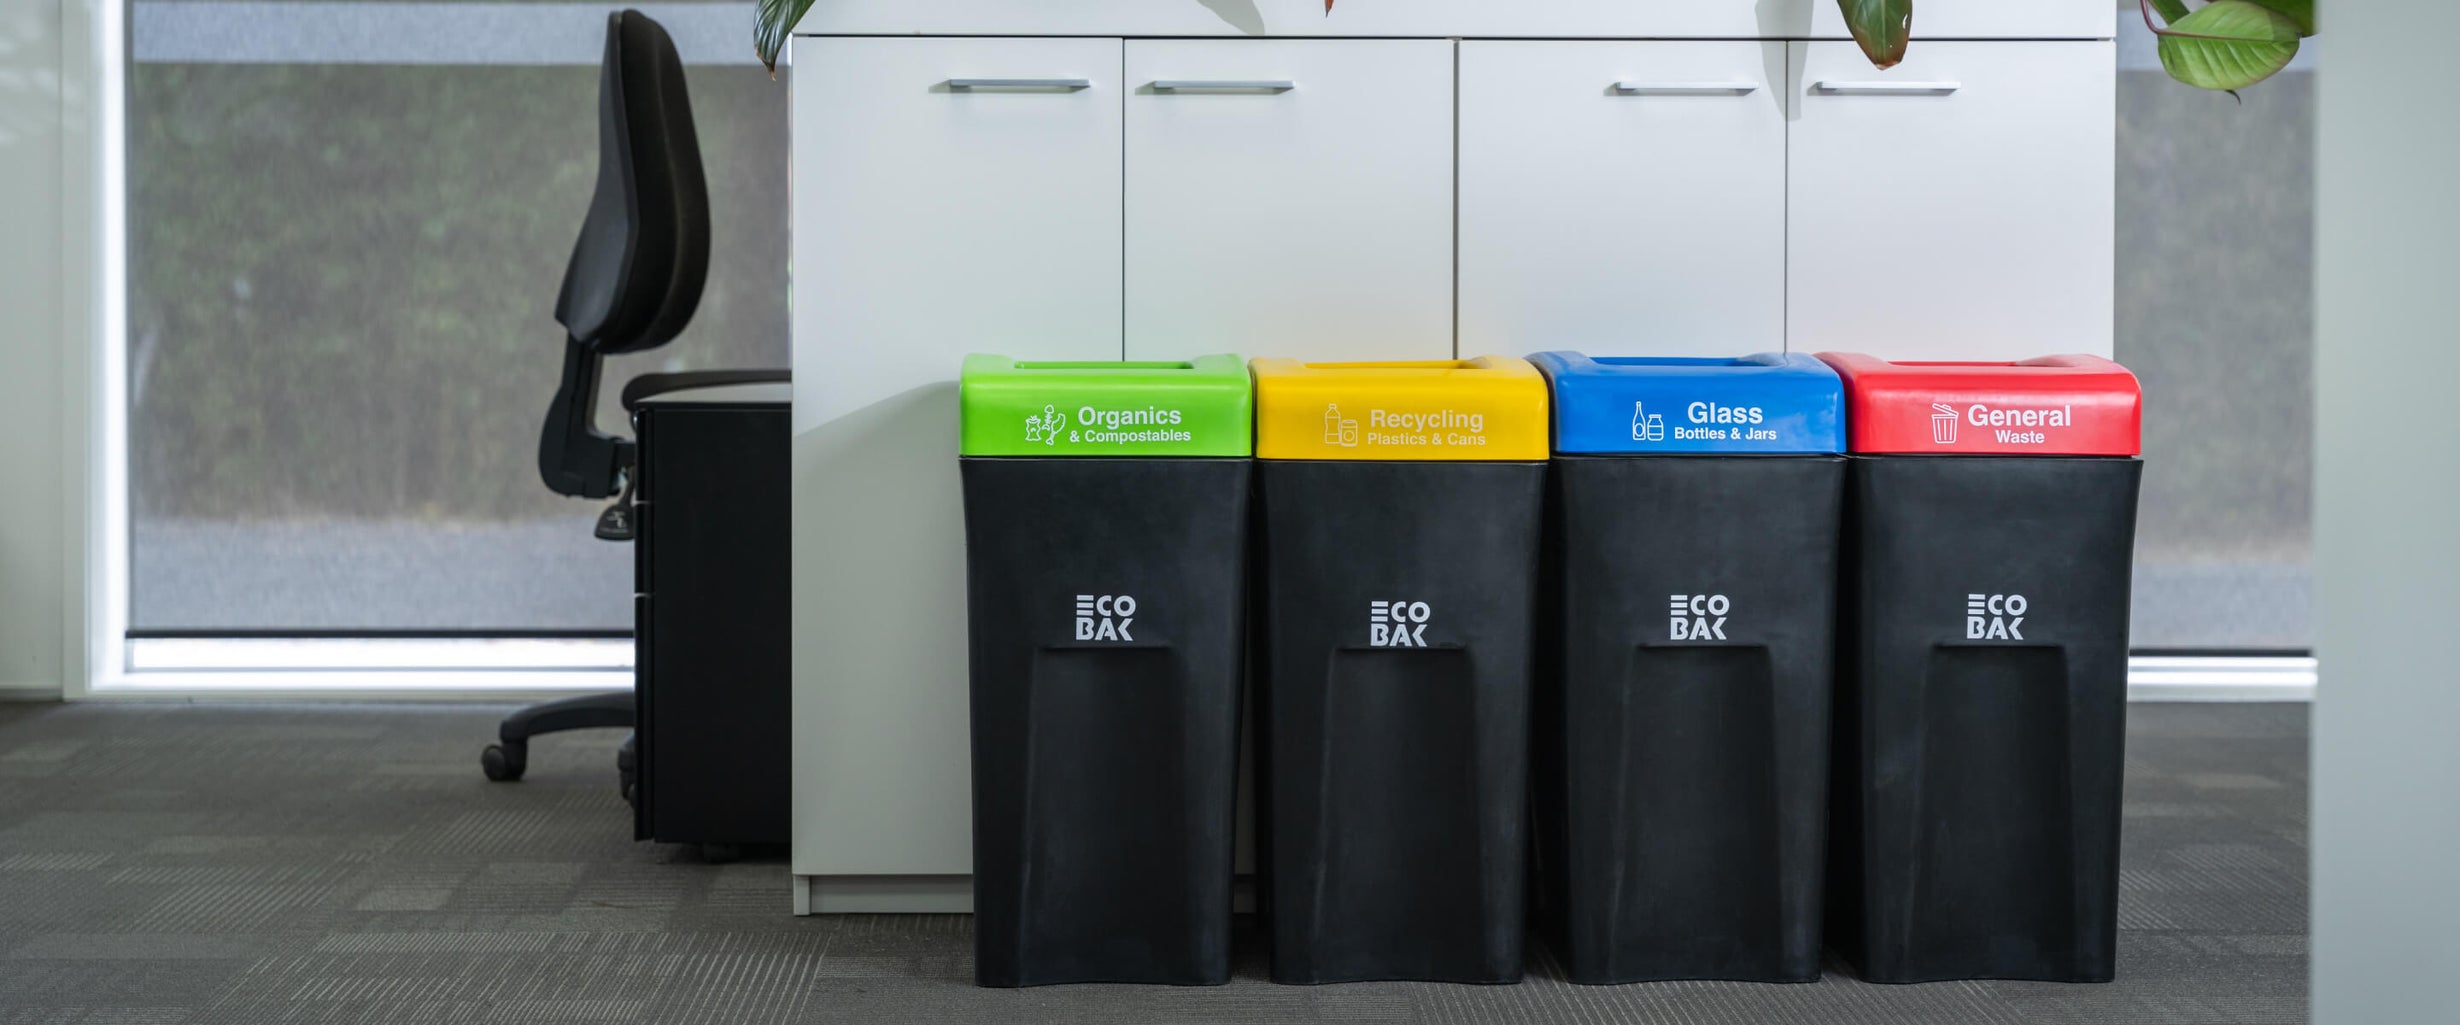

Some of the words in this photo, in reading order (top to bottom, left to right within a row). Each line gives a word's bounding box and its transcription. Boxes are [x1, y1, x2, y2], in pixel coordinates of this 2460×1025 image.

[1078, 406, 1182, 430] Organics
[1370, 409, 1484, 433] Recycling
[1687, 402, 1763, 424] Glass
[1967, 404, 2071, 426] General
[1069, 430, 1080, 443] &
[1085, 429, 1191, 445] Compostables
[1367, 433, 1427, 446] Plastics
[1431, 433, 1442, 445] &
[1447, 433, 1486, 446] Cans
[1674, 427, 1726, 440] Bottles
[1730, 428, 1741, 440] &
[1745, 427, 1777, 440] Jars
[1995, 430, 2045, 444] Waste
[1077, 595, 1136, 616] ECO
[1371, 601, 1430, 622] ECO
[1671, 595, 1729, 616] ECO
[1968, 594, 2027, 615] ECO
[1076, 618, 1133, 641] BAK
[1371, 624, 1427, 647] BAK
[1671, 617, 1726, 640] BAK
[1967, 616, 2024, 640] BAK
